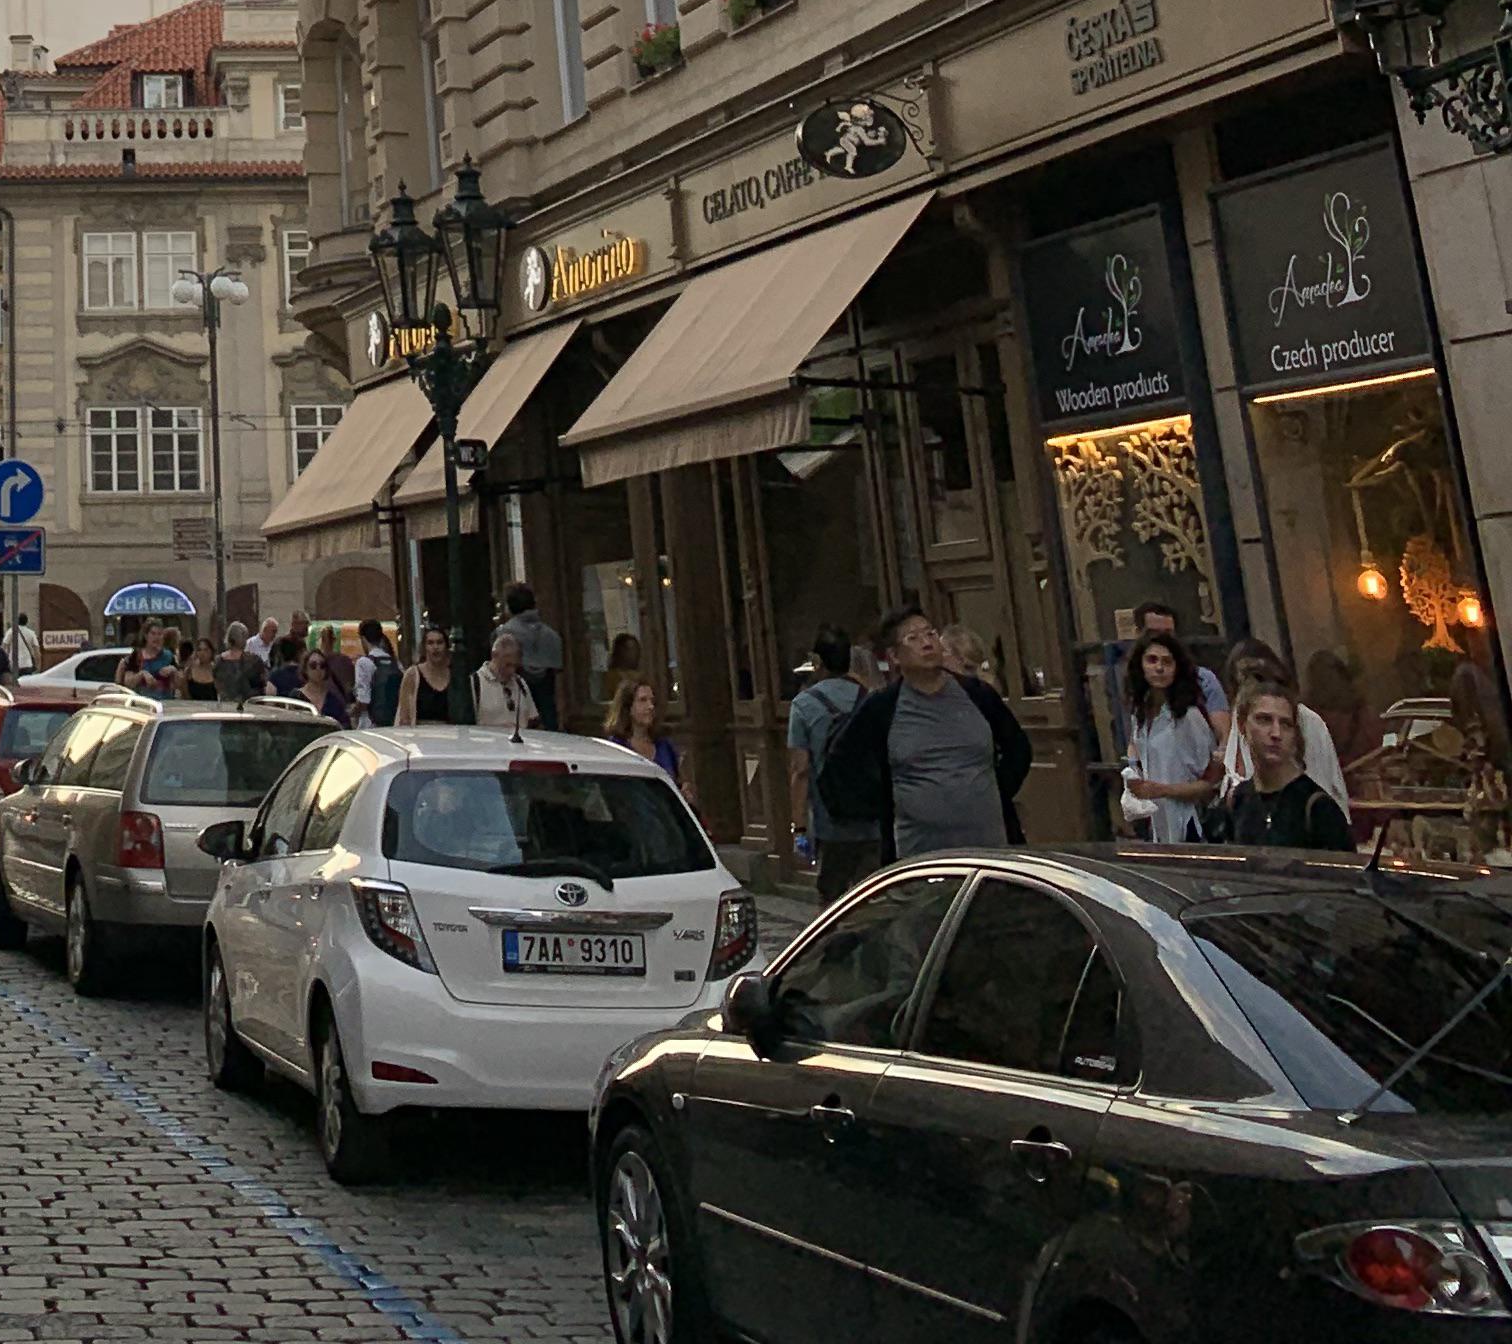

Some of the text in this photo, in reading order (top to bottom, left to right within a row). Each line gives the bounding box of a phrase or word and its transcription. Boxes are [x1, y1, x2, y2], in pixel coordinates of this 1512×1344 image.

[702, 175, 766, 224] GELATO,
[552, 236, 635, 303] Amorino
[1270, 329, 1395, 372] Czech producer
[1055, 370, 1170, 413] Wooden products
[114, 596, 186, 611] CHANGE
[523, 936, 564, 963] 7AA
[580, 938, 634, 964] 9310
